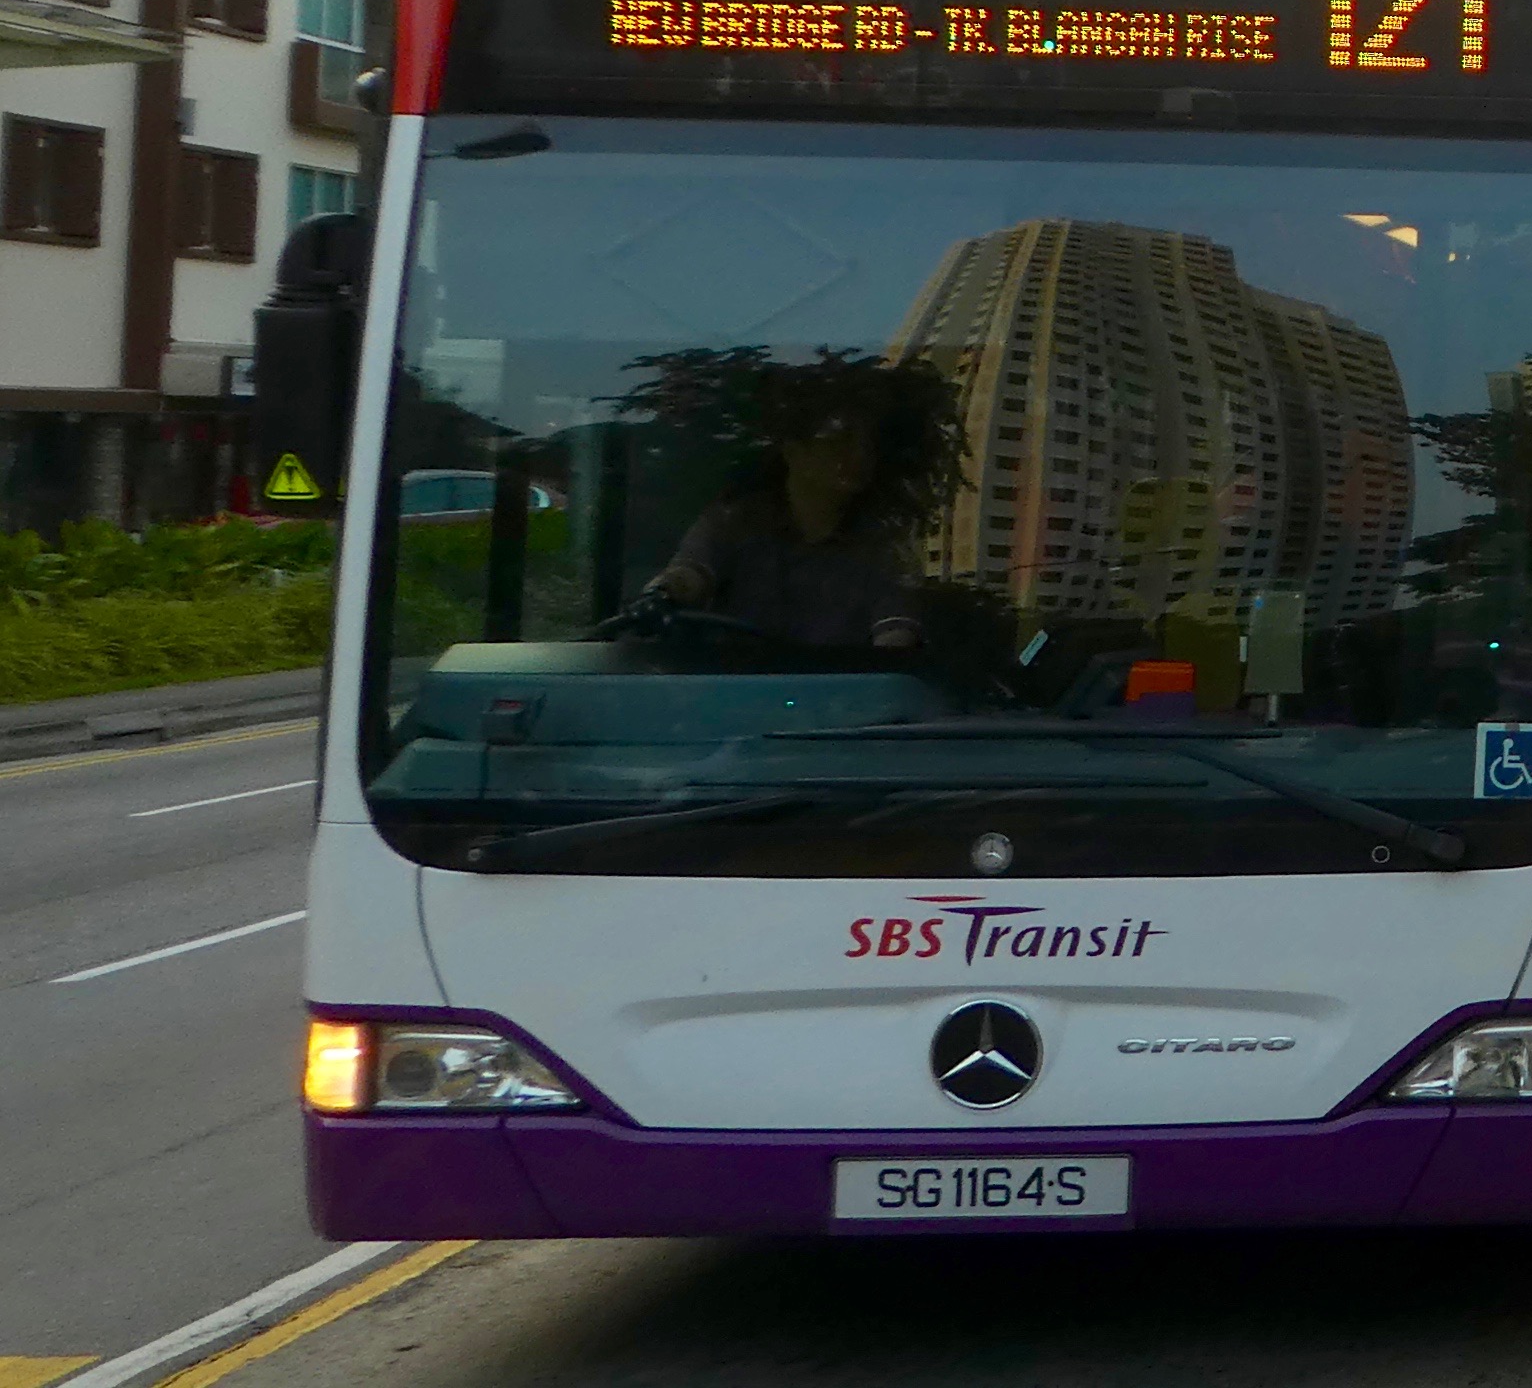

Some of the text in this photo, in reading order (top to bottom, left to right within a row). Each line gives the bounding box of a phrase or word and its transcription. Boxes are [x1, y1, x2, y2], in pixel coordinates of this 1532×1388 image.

[700, 0, 847, 50] BRIDGE
[854, 3, 906, 52] RD
[1006, 8, 1176, 58] BLANGAH
[1185, 13, 1277, 60] RISE
[844, 906, 1173, 967] SBS Transit
